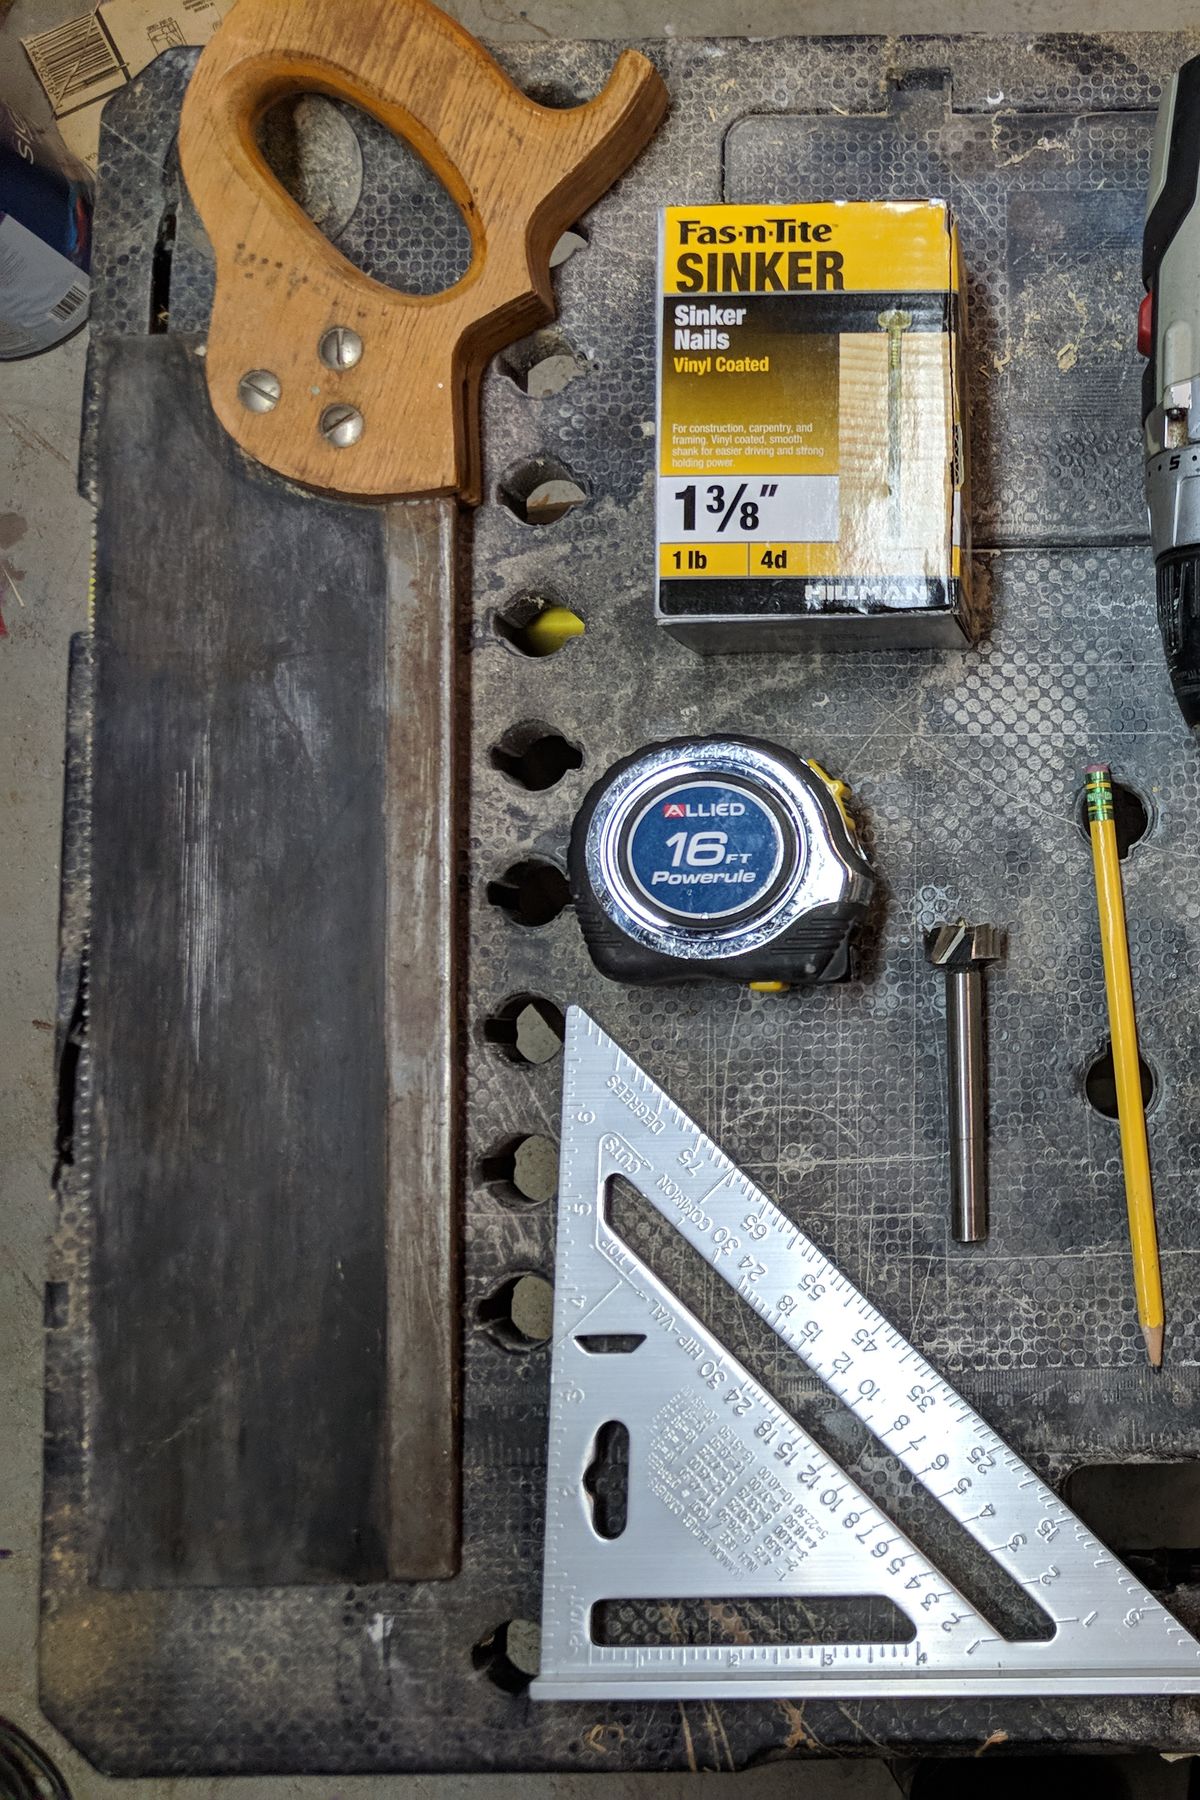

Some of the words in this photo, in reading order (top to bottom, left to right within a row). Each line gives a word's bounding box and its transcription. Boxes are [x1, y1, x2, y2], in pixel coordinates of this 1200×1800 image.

[675, 250, 845, 293] SINKER
[674, 304, 747, 327] Sinker
[674, 329, 730, 350] Nails
[673, 356, 712, 376] Vinyl
[715, 356, 770, 373] Coated
[672, 423, 687, 433] For
[689, 423, 748, 434] construction,
[749, 423, 793, 435] carpentry,
[796, 423, 813, 433] and
[672, 435, 707, 446] framing.
[711, 435, 732, 446] Vinyl
[735, 435, 767, 445] coated,
[769, 434, 803, 444] smooth
[672, 447, 698, 457] shank
[700, 447, 712, 456] for
[715, 447, 742, 456] easier
[744, 446, 774, 457] driving
[776, 446, 794, 456] and
[796, 446, 824, 457] strong
[672, 458, 704, 469] holding
[706, 459, 735, 469] power.
[1169, 455, 1181, 471] 5
[672, 551, 682, 569] 1
[688, 551, 707, 570] lb
[760, 551, 787, 569] 4d
[804, 585, 929, 601] HILLMAN
[664, 803, 745, 818] ALLIED
[651, 870, 756, 885] Powerule
[606, 1074, 666, 1135] DEGREES
[678, 1148, 704, 1177] 75
[656, 1173, 711, 1232] COMMON
[739, 1214, 770, 1240] 65
[711, 1225, 740, 1256] 30
[738, 1255, 768, 1282] 24
[798, 1273, 826, 1301] 55
[777, 1294, 799, 1317] 18
[800, 1319, 823, 1344] 15
[851, 1328, 877, 1354] 45
[832, 1352, 854, 1374] 12
[697, 1361, 728, 1390] 30
[858, 1379, 881, 1401] 10
[906, 1384, 935, 1414] 35
[723, 1387, 755, 1416] 24
[754, 1420, 781, 1445] 18
[893, 1414, 910, 1431] 8
[909, 1434, 927, 1451] 7
[774, 1443, 803, 1467] 15
[932, 1454, 949, 1471] 6
[966, 1446, 996, 1475] 25
[797, 1465, 821, 1489] 12
[953, 1476, 972, 1495] 5
[819, 1489, 845, 1514] 10
[979, 1503, 996, 1519] 4
[841, 1512, 861, 1530] 8
[853, 1529, 875, 1544] 7
[1007, 1533, 1027, 1552] 3
[870, 1541, 890, 1558] 6
[886, 1558, 906, 1575] 5
[1039, 1565, 1060, 1585] 2
[903, 1576, 922, 1591] 4
[919, 1593, 940, 1611] 3
[941, 1612, 961, 1632] 2
